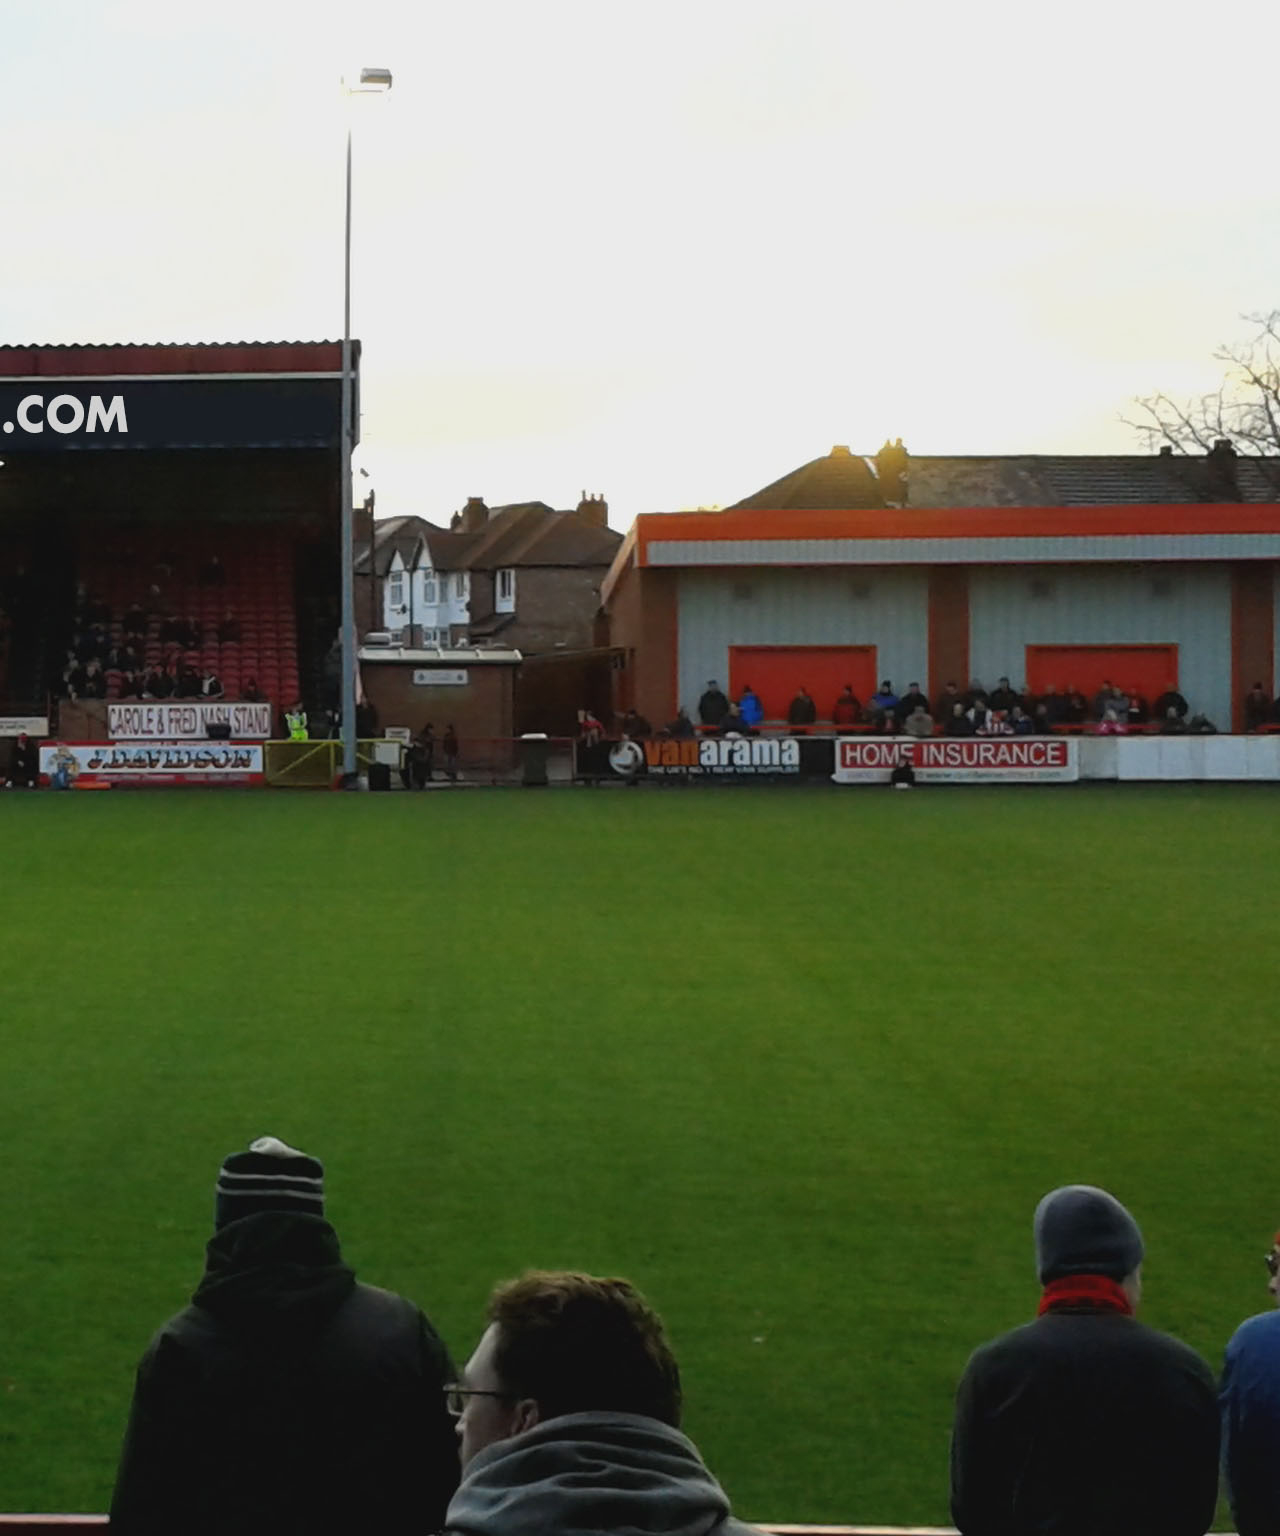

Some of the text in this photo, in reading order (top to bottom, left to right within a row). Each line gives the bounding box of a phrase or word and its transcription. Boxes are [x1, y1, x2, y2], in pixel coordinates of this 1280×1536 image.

[110, 707, 154, 735] CAROLE
[157, 708, 165, 734] &
[169, 707, 197, 734] FRED
[234, 707, 270, 735] STAND
[644, 739, 800, 766] vanarama
[845, 742, 1062, 766] HOME INSURANCE
